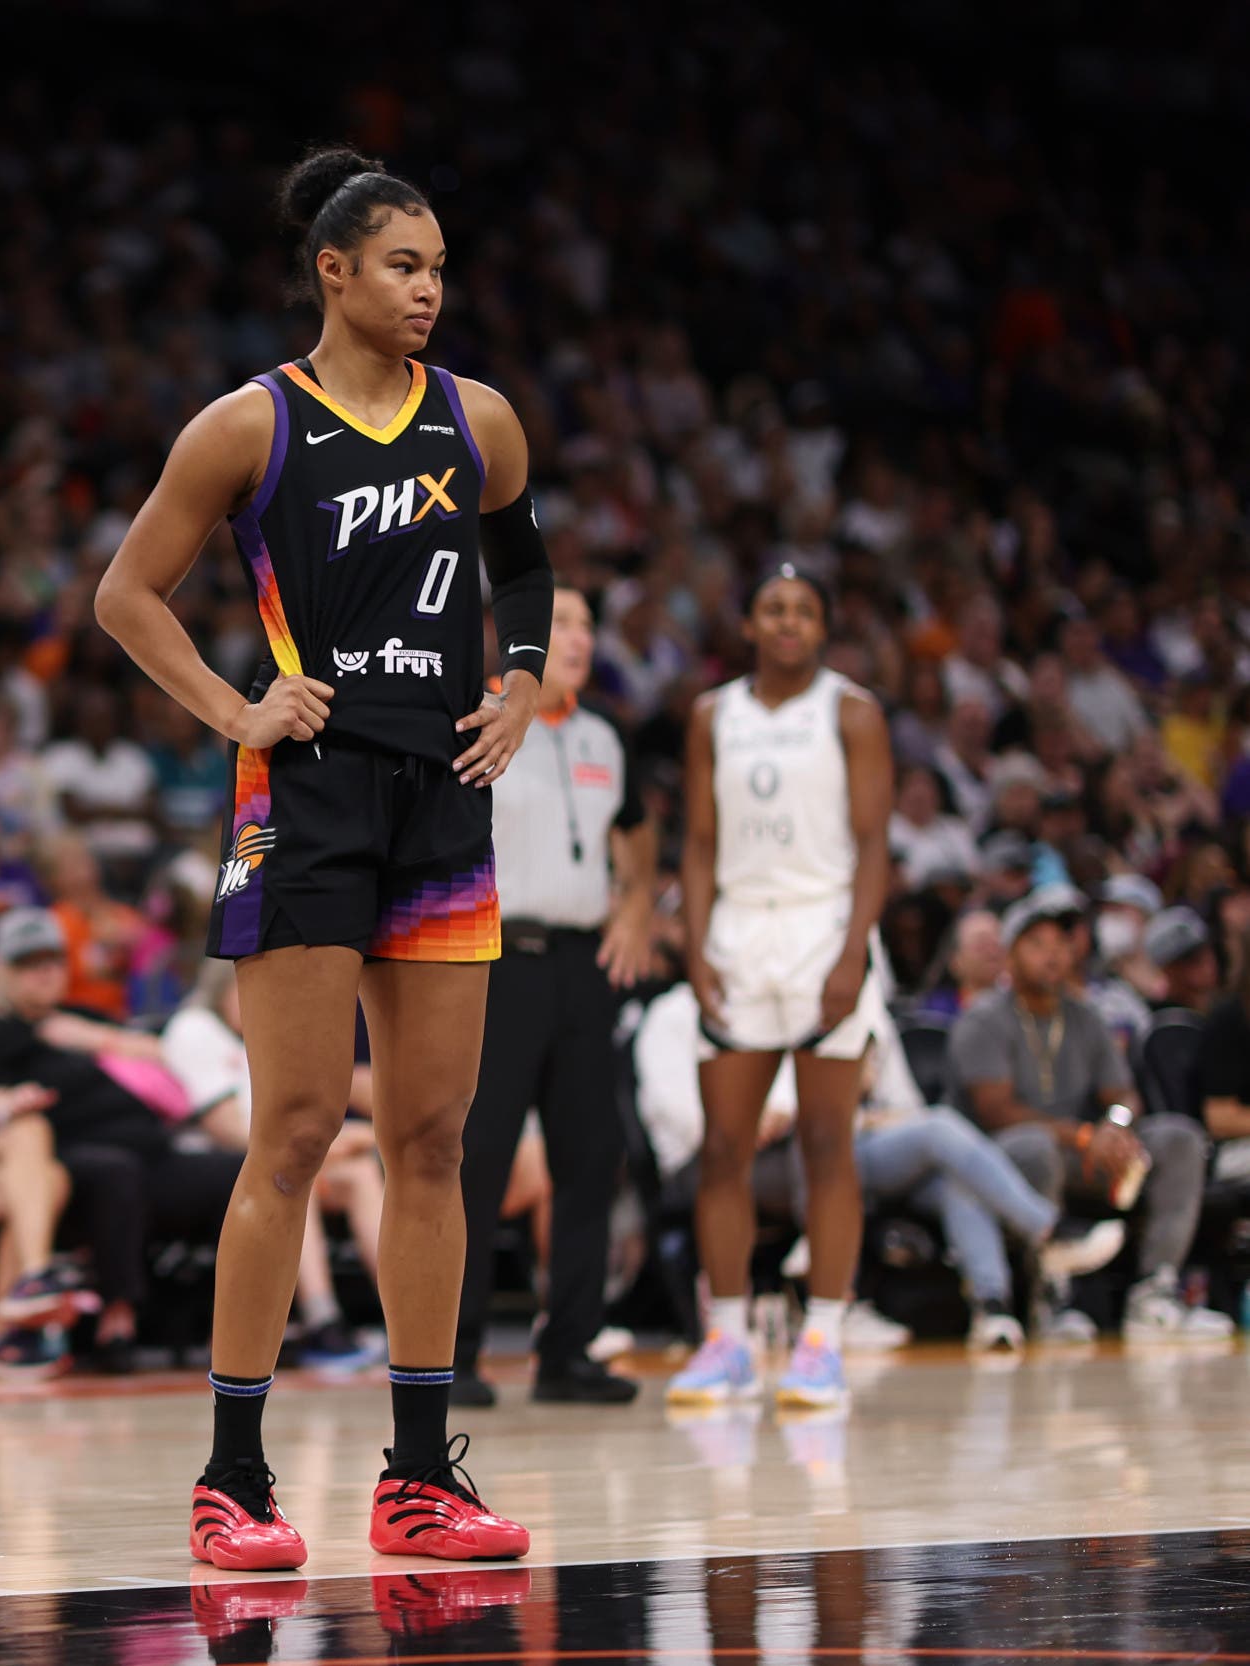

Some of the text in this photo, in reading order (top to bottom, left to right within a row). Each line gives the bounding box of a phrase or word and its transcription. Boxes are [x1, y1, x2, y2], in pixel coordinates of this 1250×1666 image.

[323, 467, 461, 556] PHX
[415, 549, 459, 615] 0
[376, 637, 443, 678] fry's
